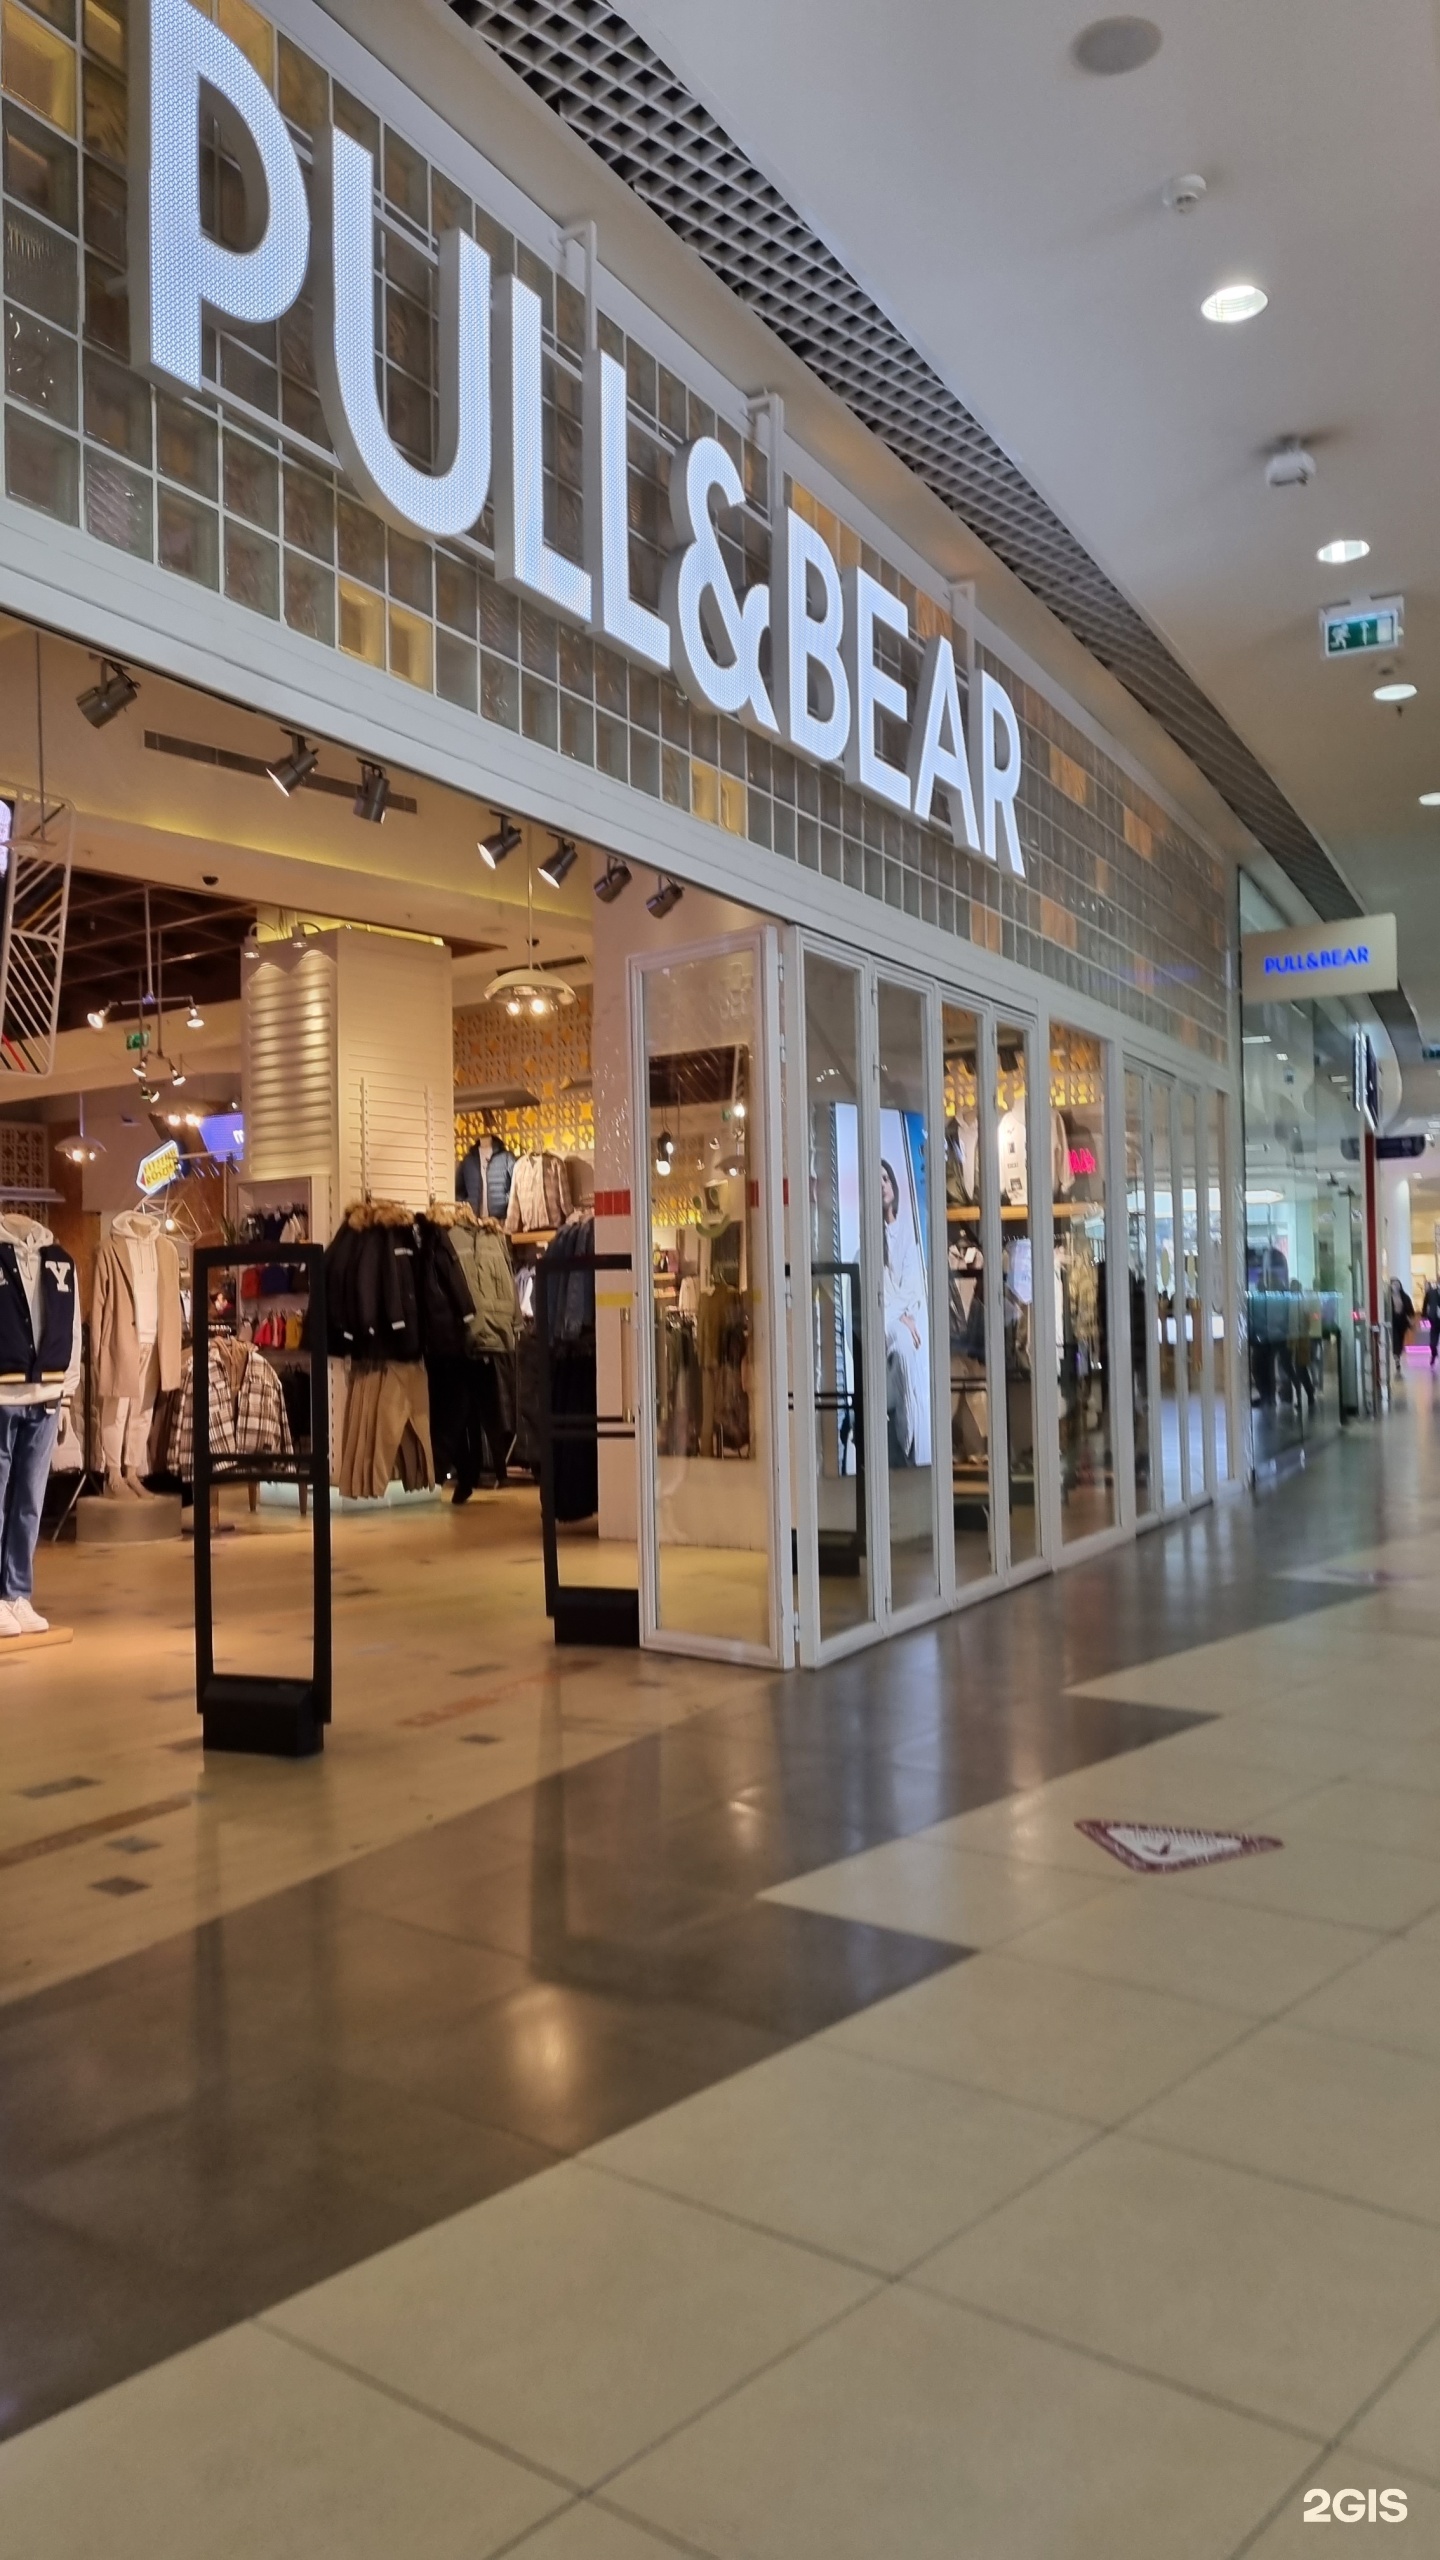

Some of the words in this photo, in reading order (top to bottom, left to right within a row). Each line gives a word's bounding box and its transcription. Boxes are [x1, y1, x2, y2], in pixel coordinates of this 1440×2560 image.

[146, 0, 1026, 878] PULL&BEAR
[1264, 945, 1370, 975] PULL&BEAR
[44, 1260, 71, 1293] Y
